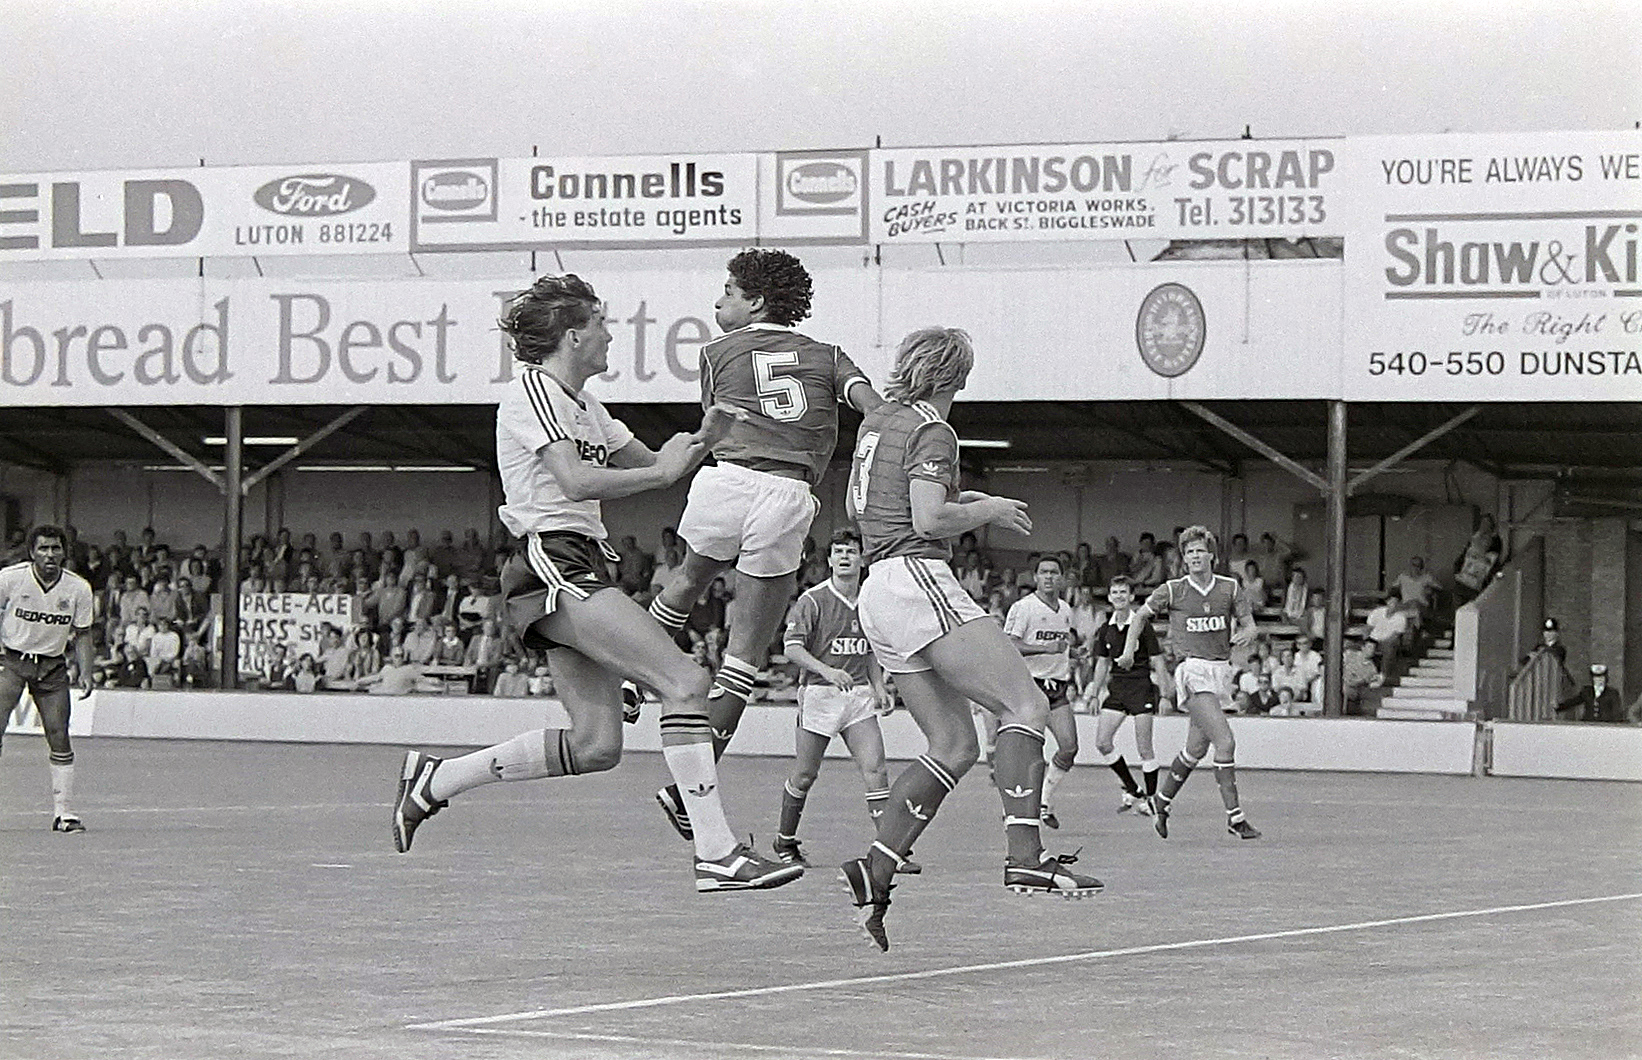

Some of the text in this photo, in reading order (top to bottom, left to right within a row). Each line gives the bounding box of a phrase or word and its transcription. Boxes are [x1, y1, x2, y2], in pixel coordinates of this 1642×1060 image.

[530, 163, 724, 200] Connells
[884, 153, 1132, 197] LARKINSON
[1188, 149, 1335, 190] SCRAP
[1382, 158, 1473, 185] YOU'RE
[1485, 155, 1584, 183] ALWAYS
[273, 176, 352, 212] Ford
[965, 202, 986, 214] AT
[996, 200, 1077, 214] VICTORIA
[532, 209, 567, 228] the
[573, 207, 645, 227] estate
[656, 203, 742, 235] agents
[883, 201, 936, 223] CASH
[887, 212, 958, 237] BUYERS
[965, 217, 1008, 231] BACK
[1038, 214, 1156, 231] BIGGLESWADE
[1174, 195, 1327, 227] Tel. 313133
[236, 222, 394, 246] LUTON 881224
[0, 296, 234, 387] bread
[268, 292, 459, 386] Best
[1462, 312, 1509, 337] The
[1523, 311, 1607, 345] Right
[1367, 350, 1506, 376] 540-550
[751, 350, 808, 422] 5
[15, 608, 72, 626] BEDFORD
